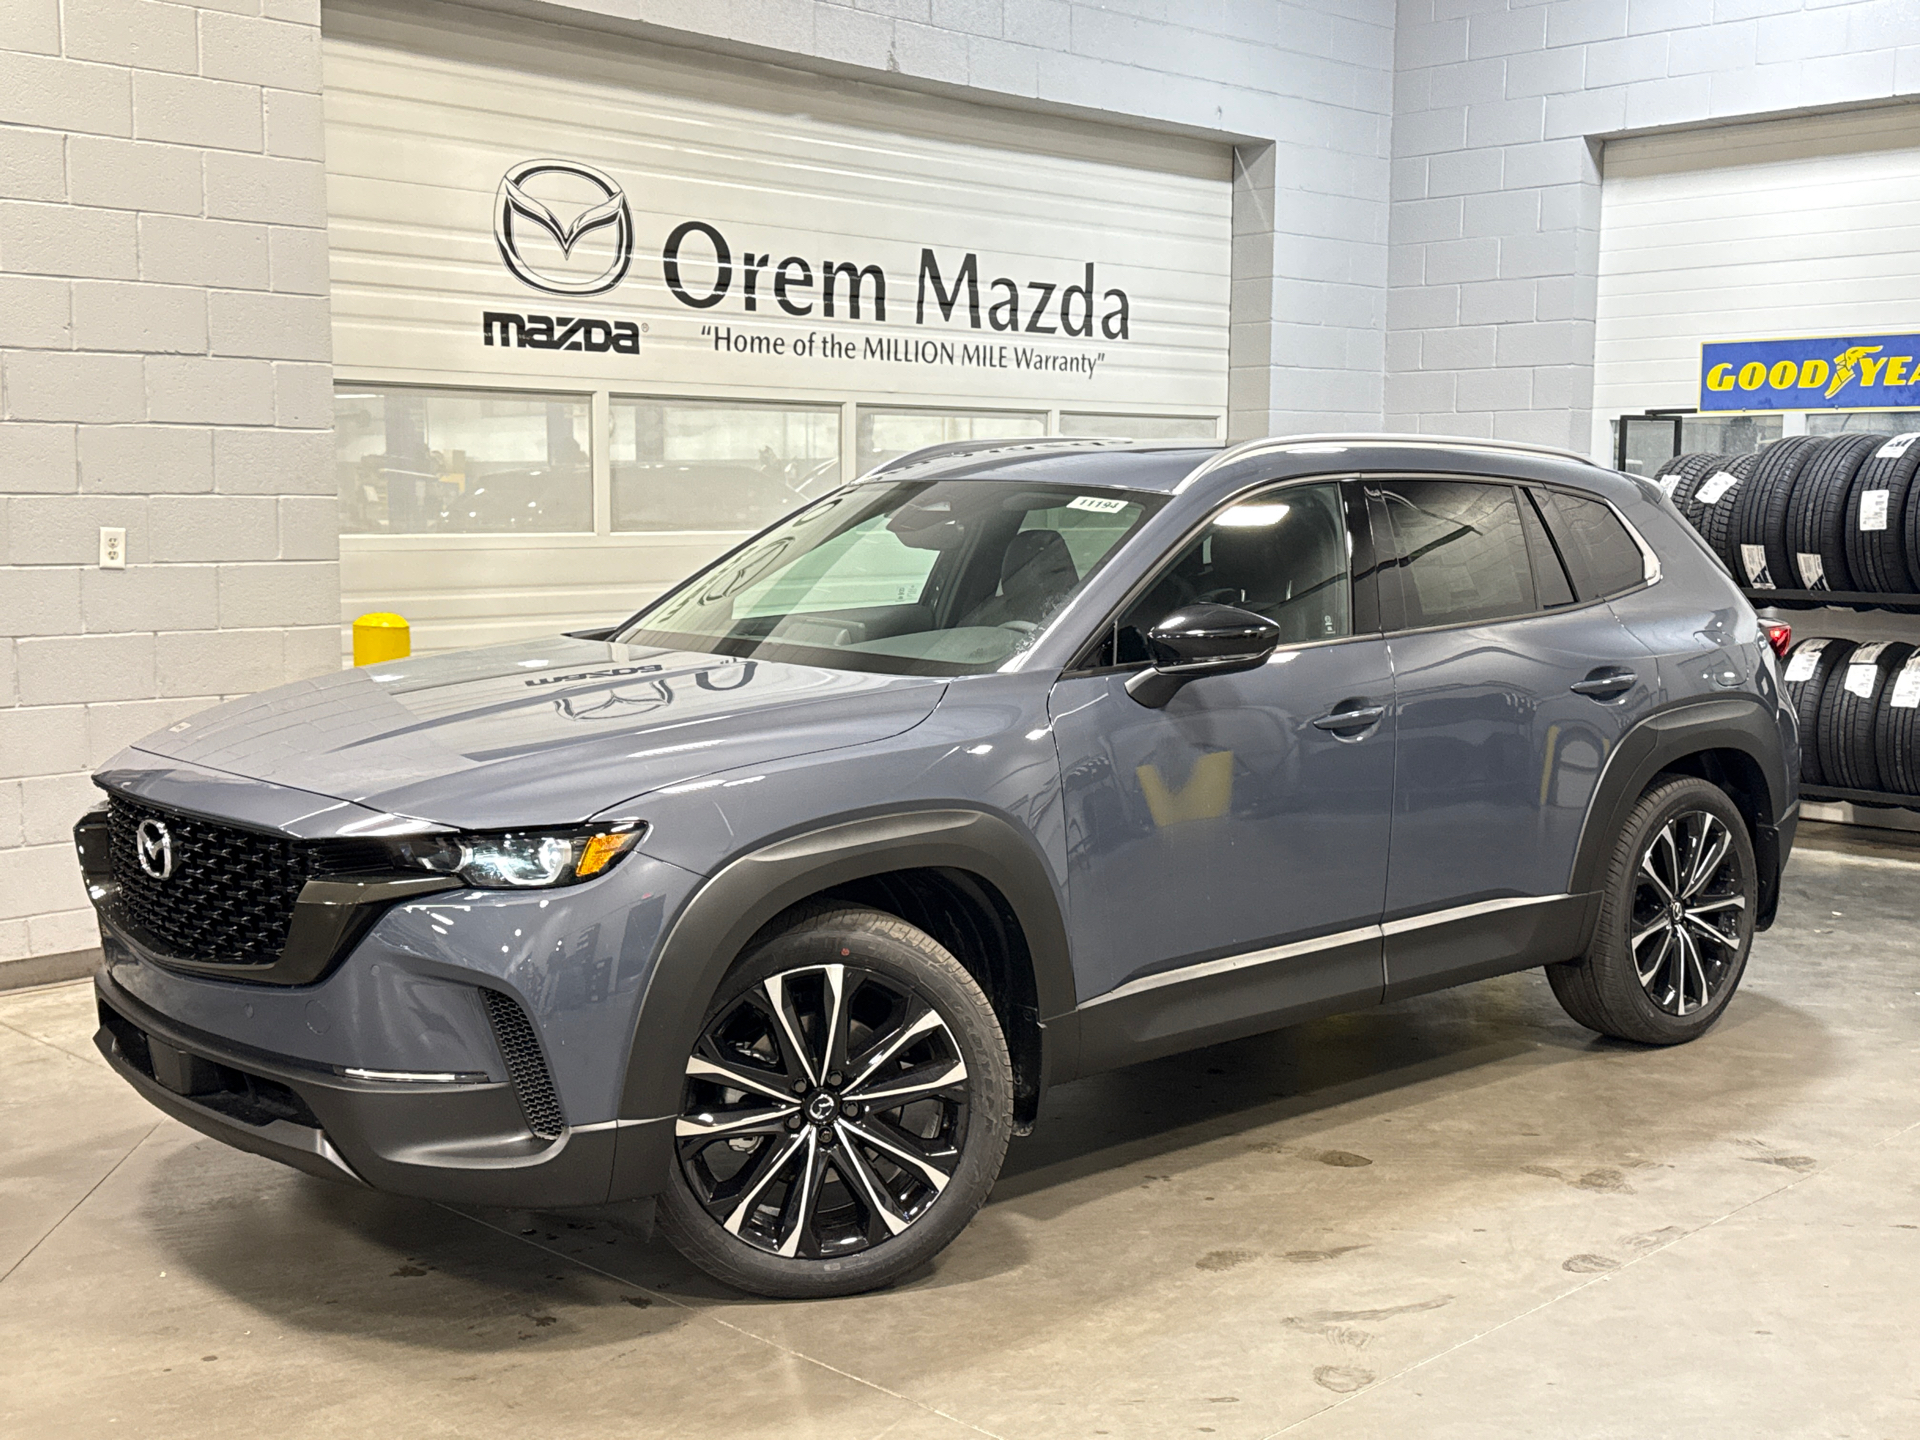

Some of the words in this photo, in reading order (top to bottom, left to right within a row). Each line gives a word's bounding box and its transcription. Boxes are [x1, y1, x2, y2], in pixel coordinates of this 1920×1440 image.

[663, 221, 886, 322] Orem
[915, 247, 1130, 340] Mazda
[793, 332, 817, 357] of
[822, 333, 856, 359] the
[863, 337, 954, 366] MILLION
[962, 344, 1008, 368] MILE
